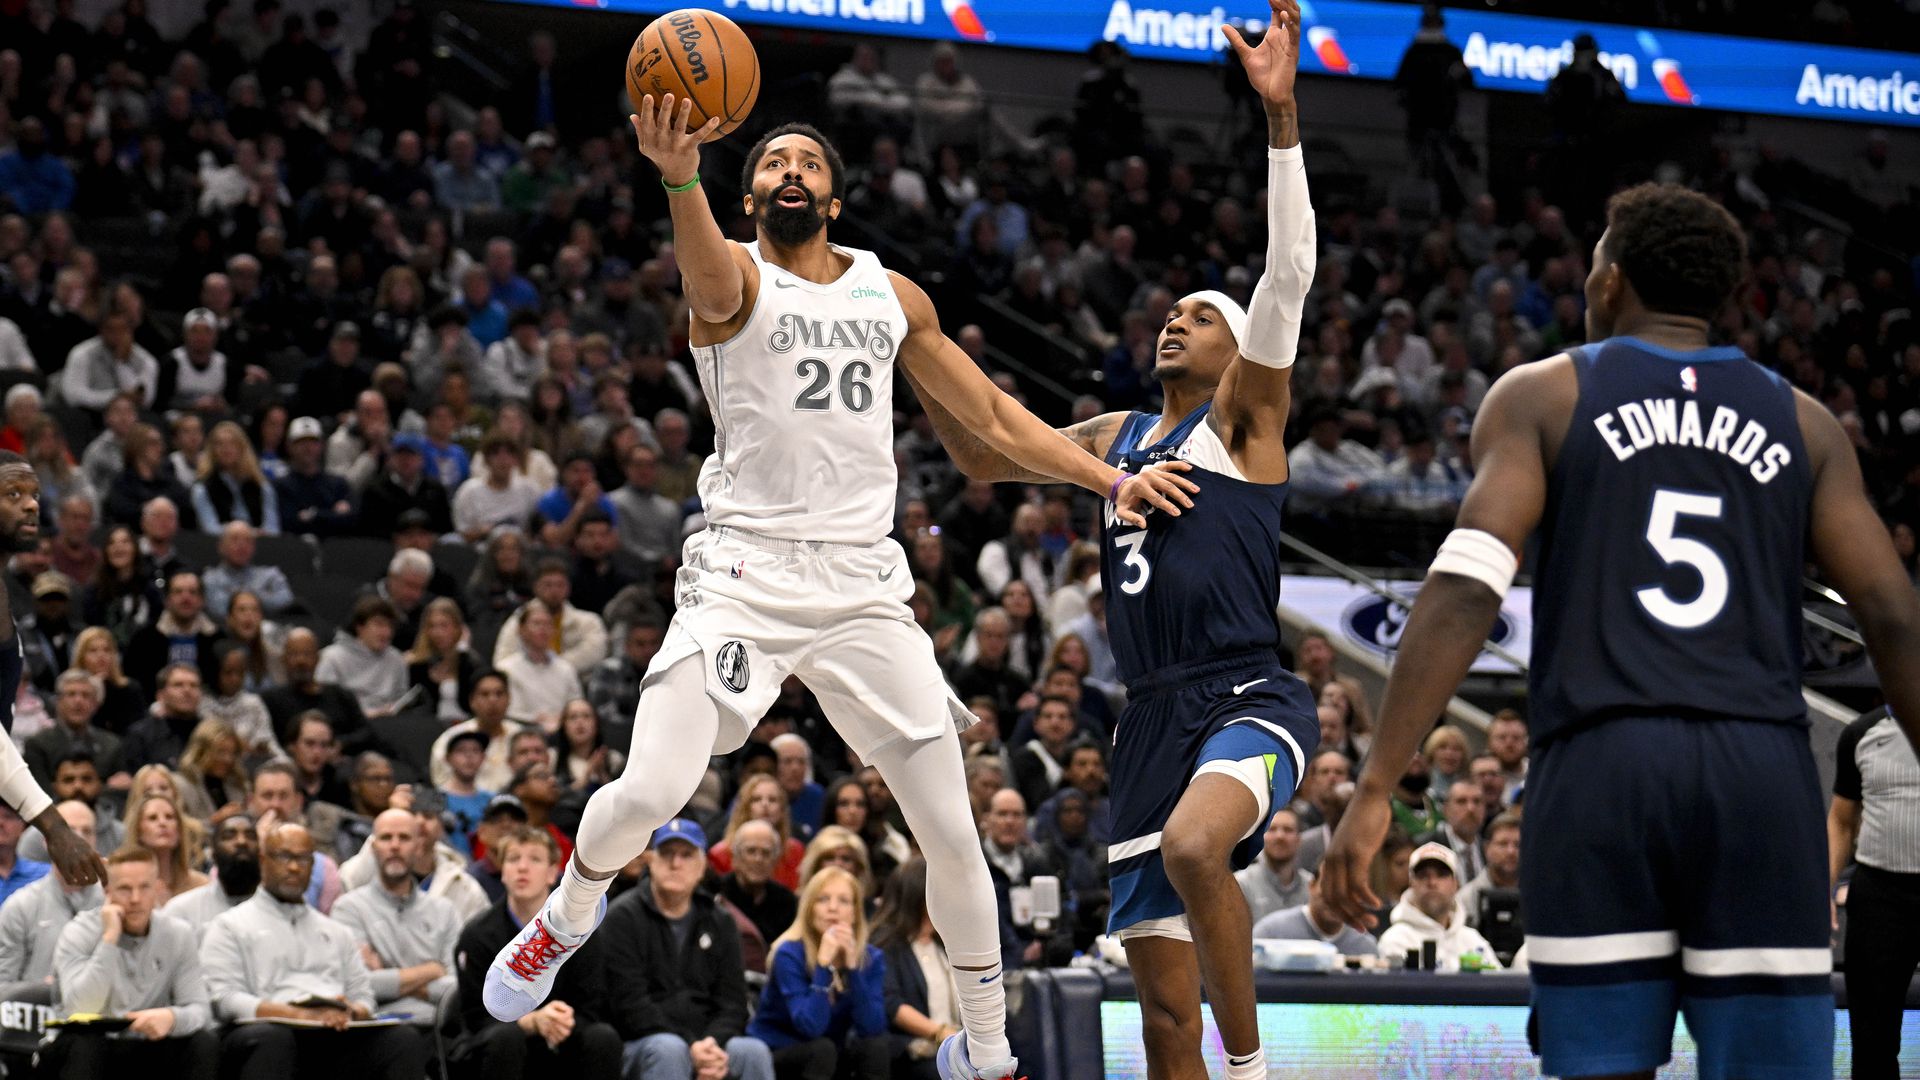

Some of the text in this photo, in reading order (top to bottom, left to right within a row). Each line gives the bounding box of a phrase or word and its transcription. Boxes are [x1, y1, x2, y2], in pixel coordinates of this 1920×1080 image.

[669, 12, 709, 85] Wilson
[1462, 31, 1638, 89] Amerin
[851, 286, 887, 299] chime
[769, 313, 894, 362] MAVS
[793, 357, 873, 414] 26
[1594, 398, 1791, 484] EDWARDS
[1114, 530, 1151, 595] 3
[1637, 489, 1729, 629] 5
[0, 1000, 33, 1032] GET
